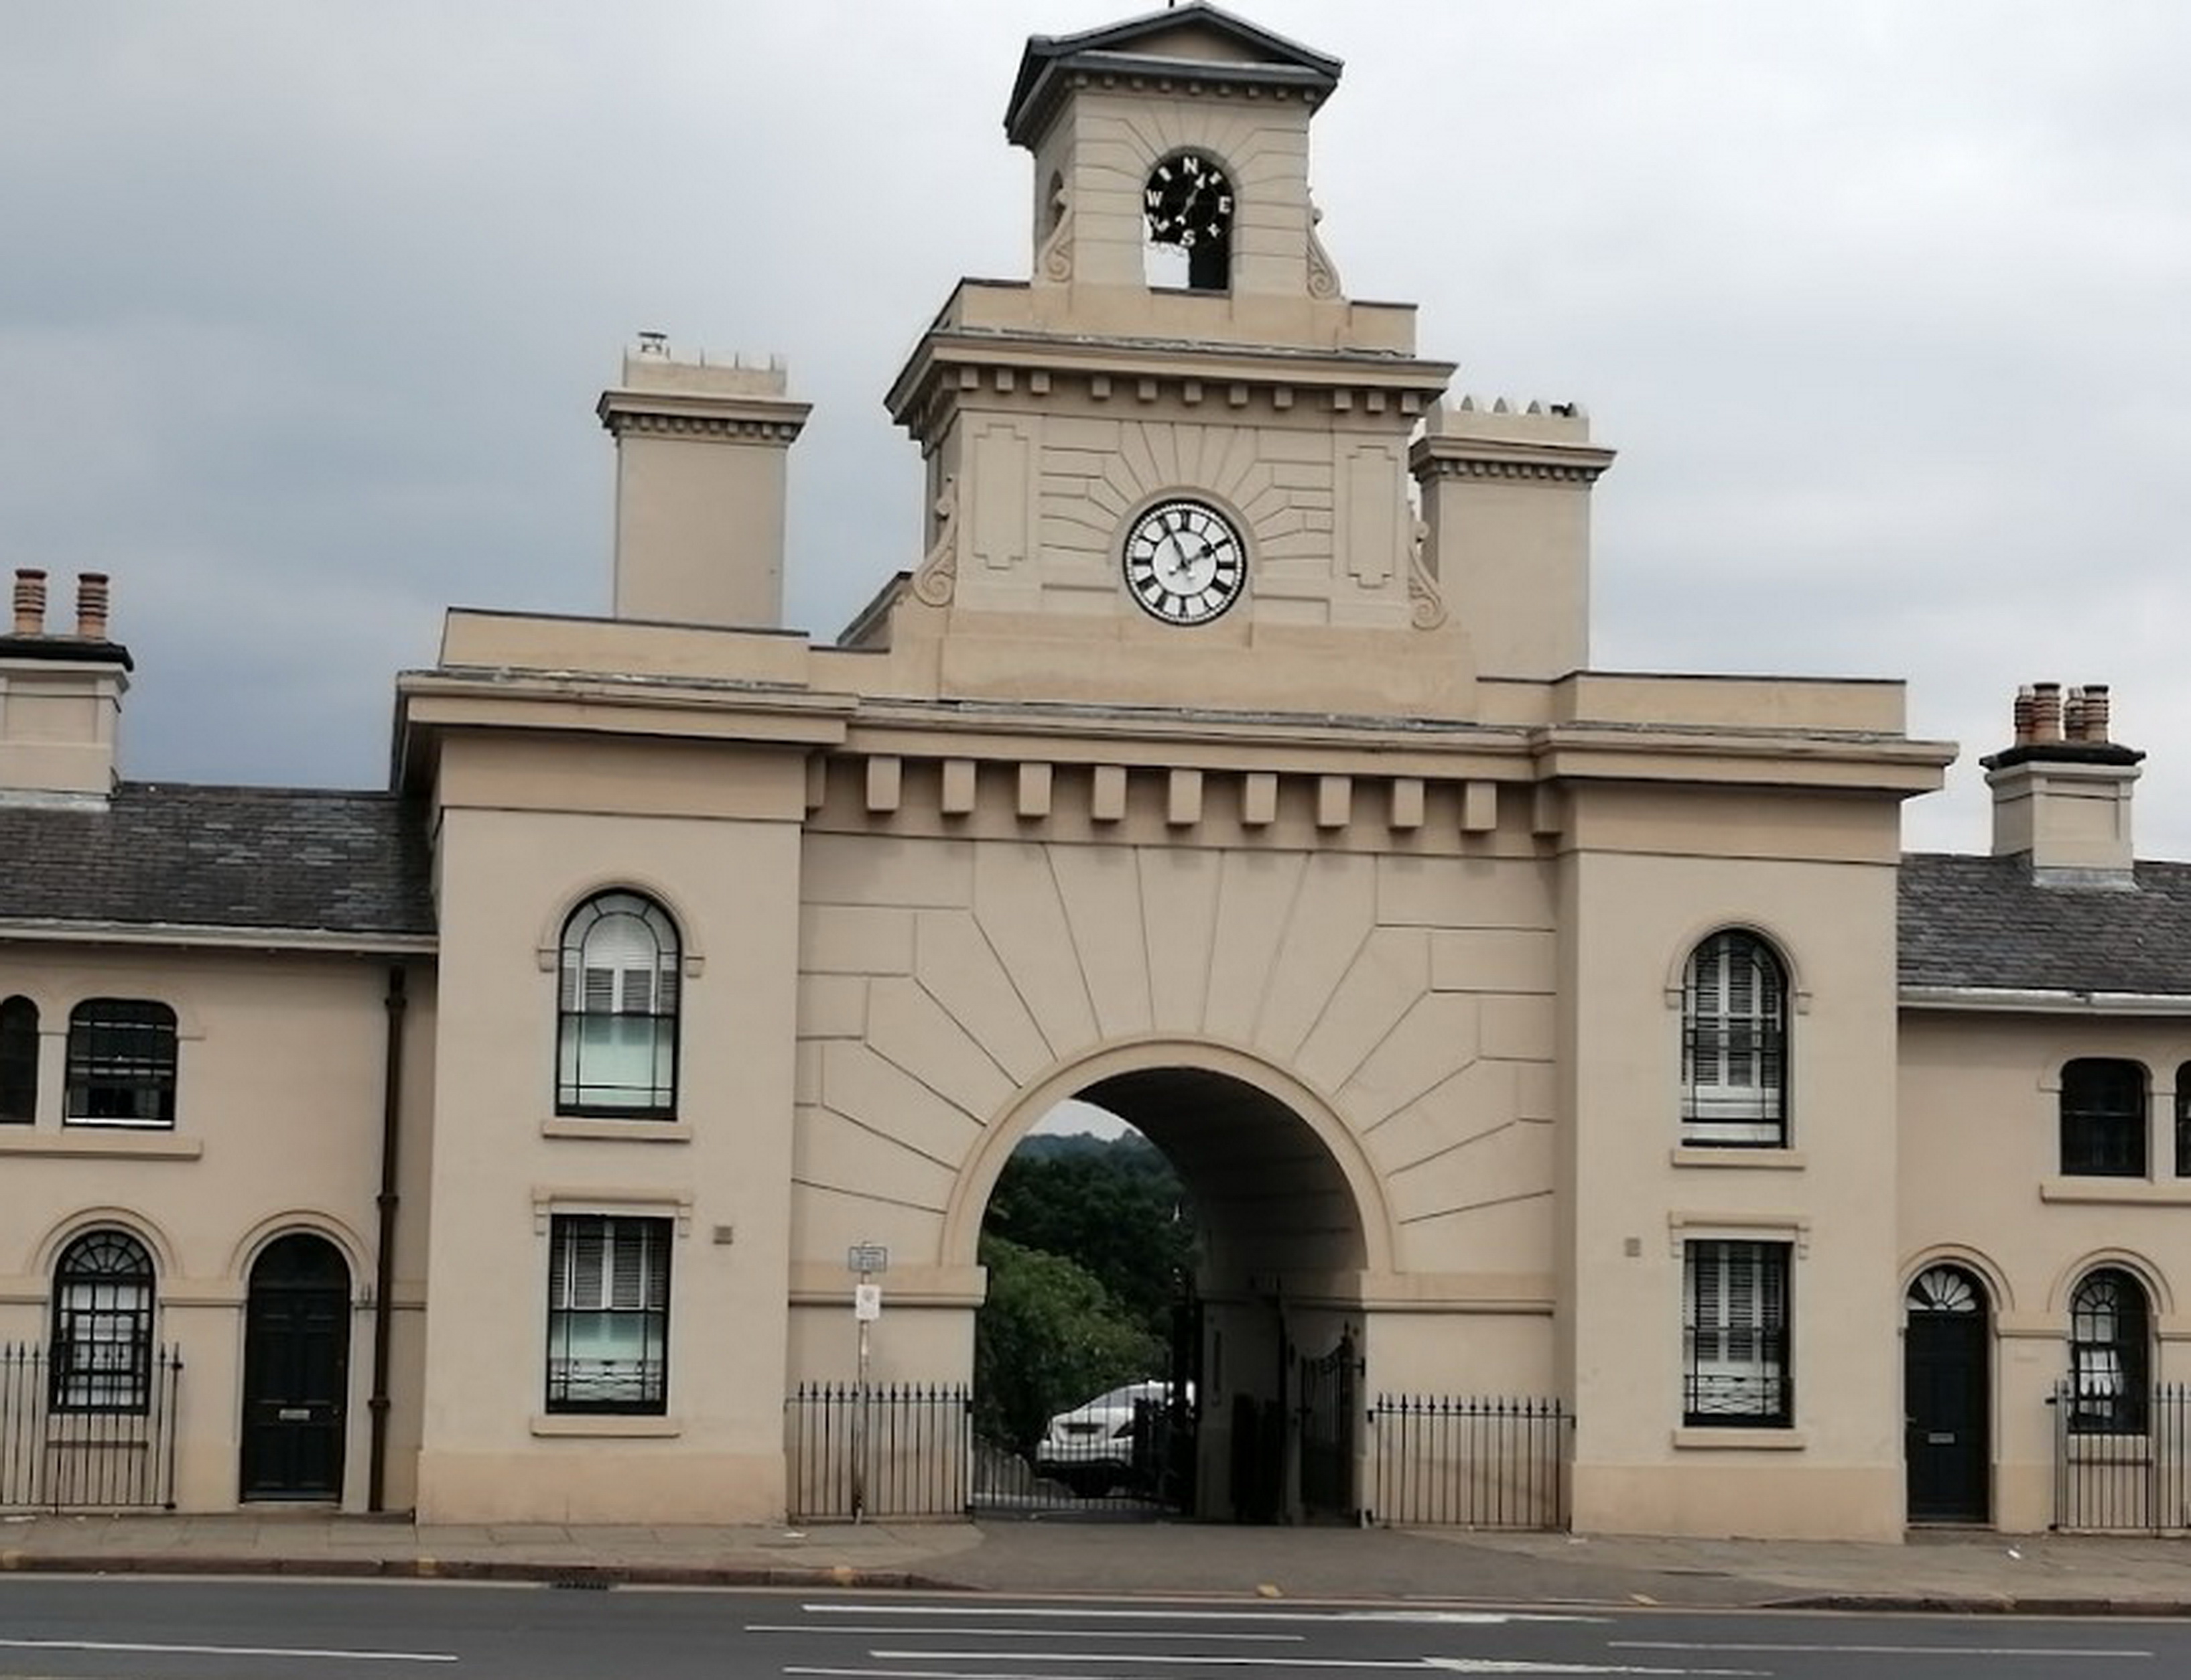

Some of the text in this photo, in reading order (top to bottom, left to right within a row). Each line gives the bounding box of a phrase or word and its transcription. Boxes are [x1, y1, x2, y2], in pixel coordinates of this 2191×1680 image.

[1183, 157, 1198, 175] N
[1146, 189, 1163, 207] W
[1219, 196, 1232, 214] E
[1180, 229, 1196, 247] S
